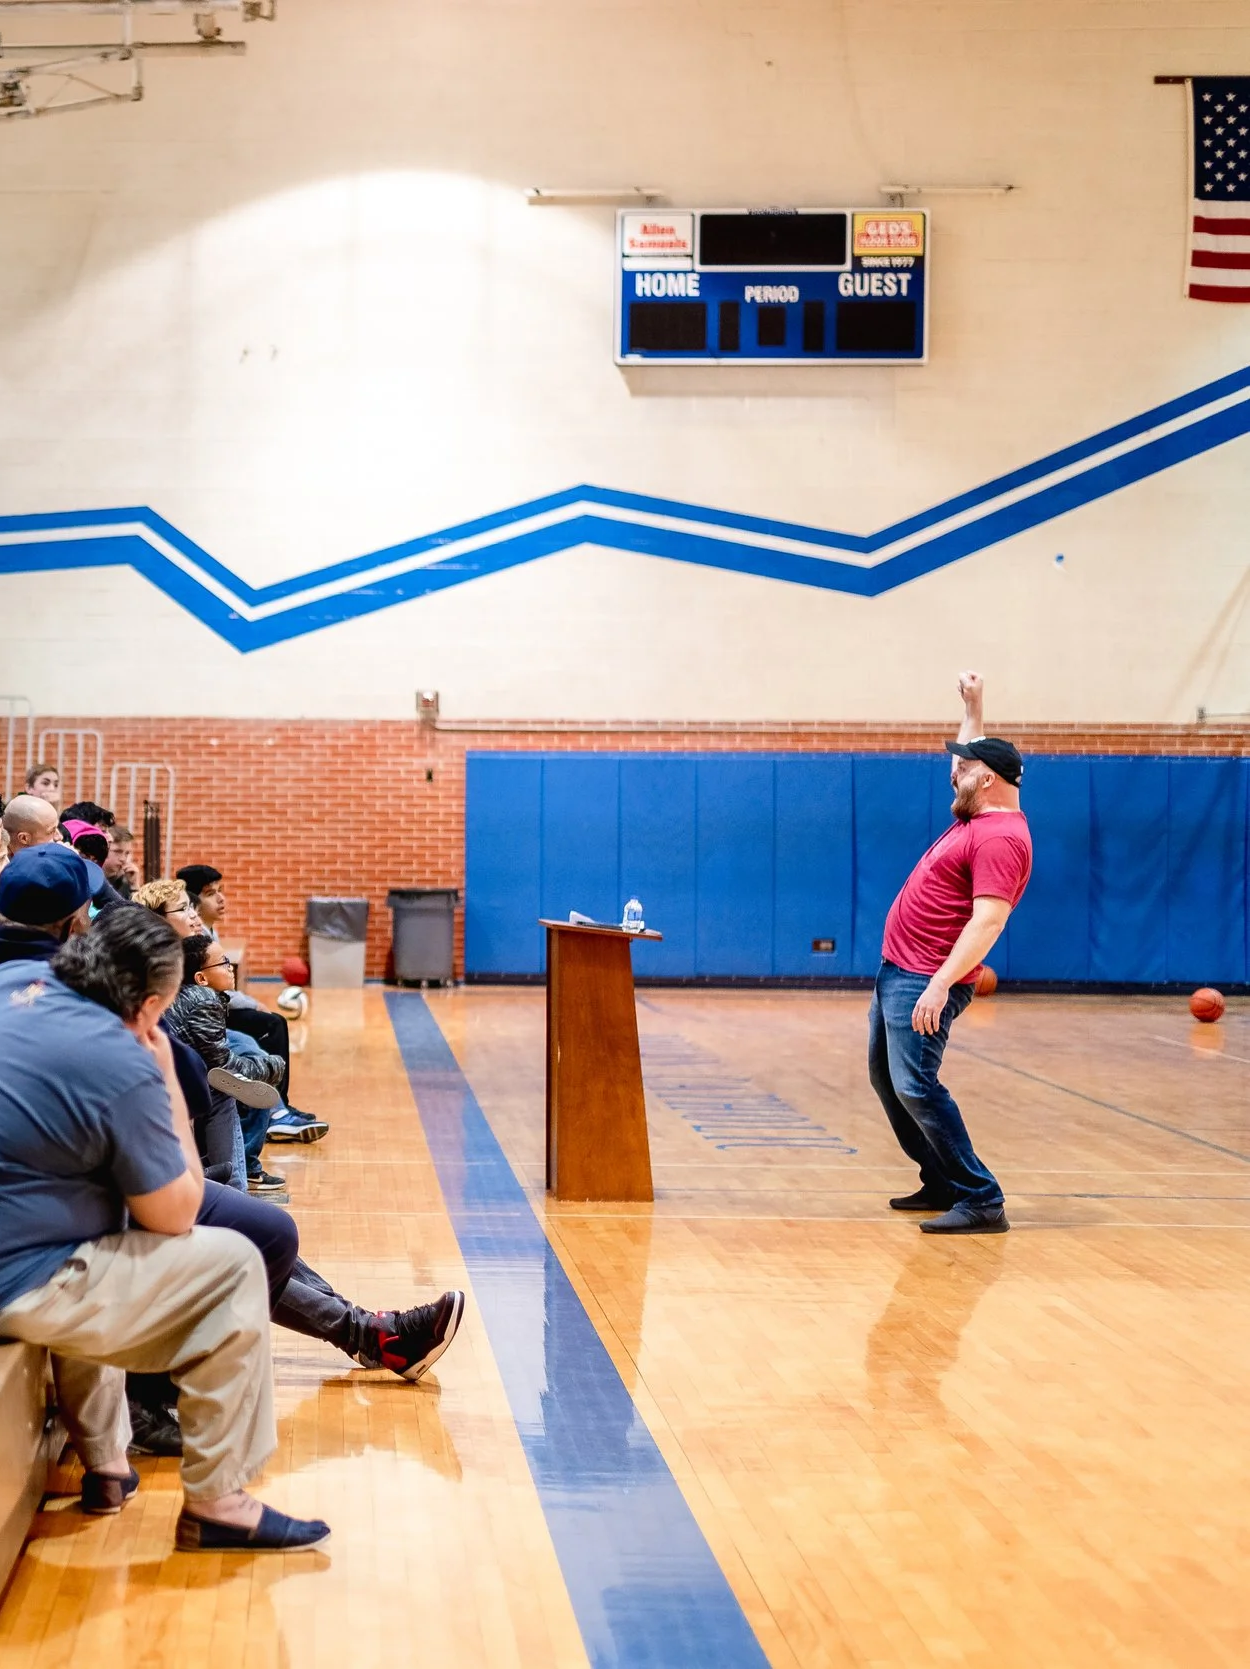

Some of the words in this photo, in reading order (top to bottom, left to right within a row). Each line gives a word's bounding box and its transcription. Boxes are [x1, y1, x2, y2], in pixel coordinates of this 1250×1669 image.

[635, 272, 701, 297] HOME
[745, 285, 799, 303] PERIOD
[838, 272, 912, 297] GUEST
